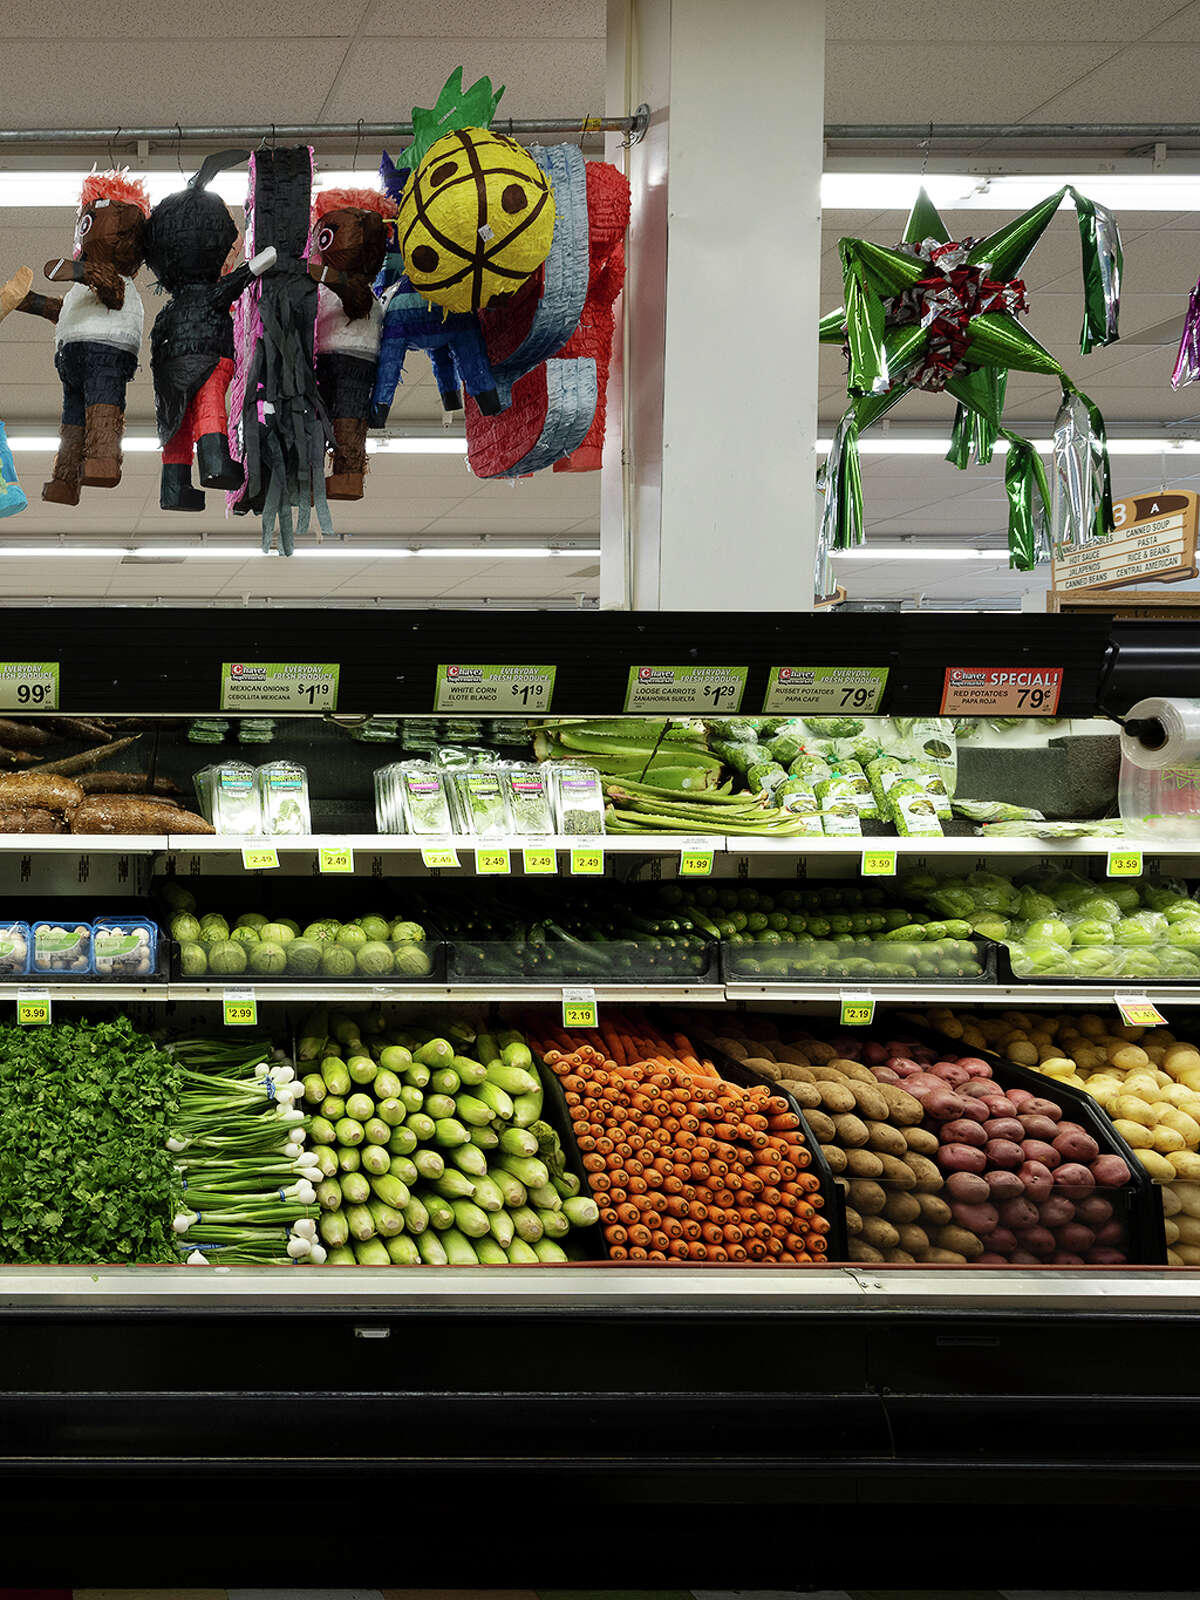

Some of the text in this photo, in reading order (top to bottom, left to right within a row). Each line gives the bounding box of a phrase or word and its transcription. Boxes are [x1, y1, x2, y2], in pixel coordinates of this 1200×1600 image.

[1150, 503, 1160, 514] A
[1126, 520, 1170, 538] CANNED SOUP
[1137, 536, 1158, 547] PASTA
[1068, 550, 1100, 565] HOT SAUCE
[1128, 552, 1142, 562] RICE
[1149, 545, 1171, 557] BEANS
[1116, 556, 1178, 578] CENTRAL AMERICAN
[1065, 573, 1108, 589] CANNED BEANS
[951, 671, 986, 680] Chavez
[990, 672, 1058, 686] SPECIAL!
